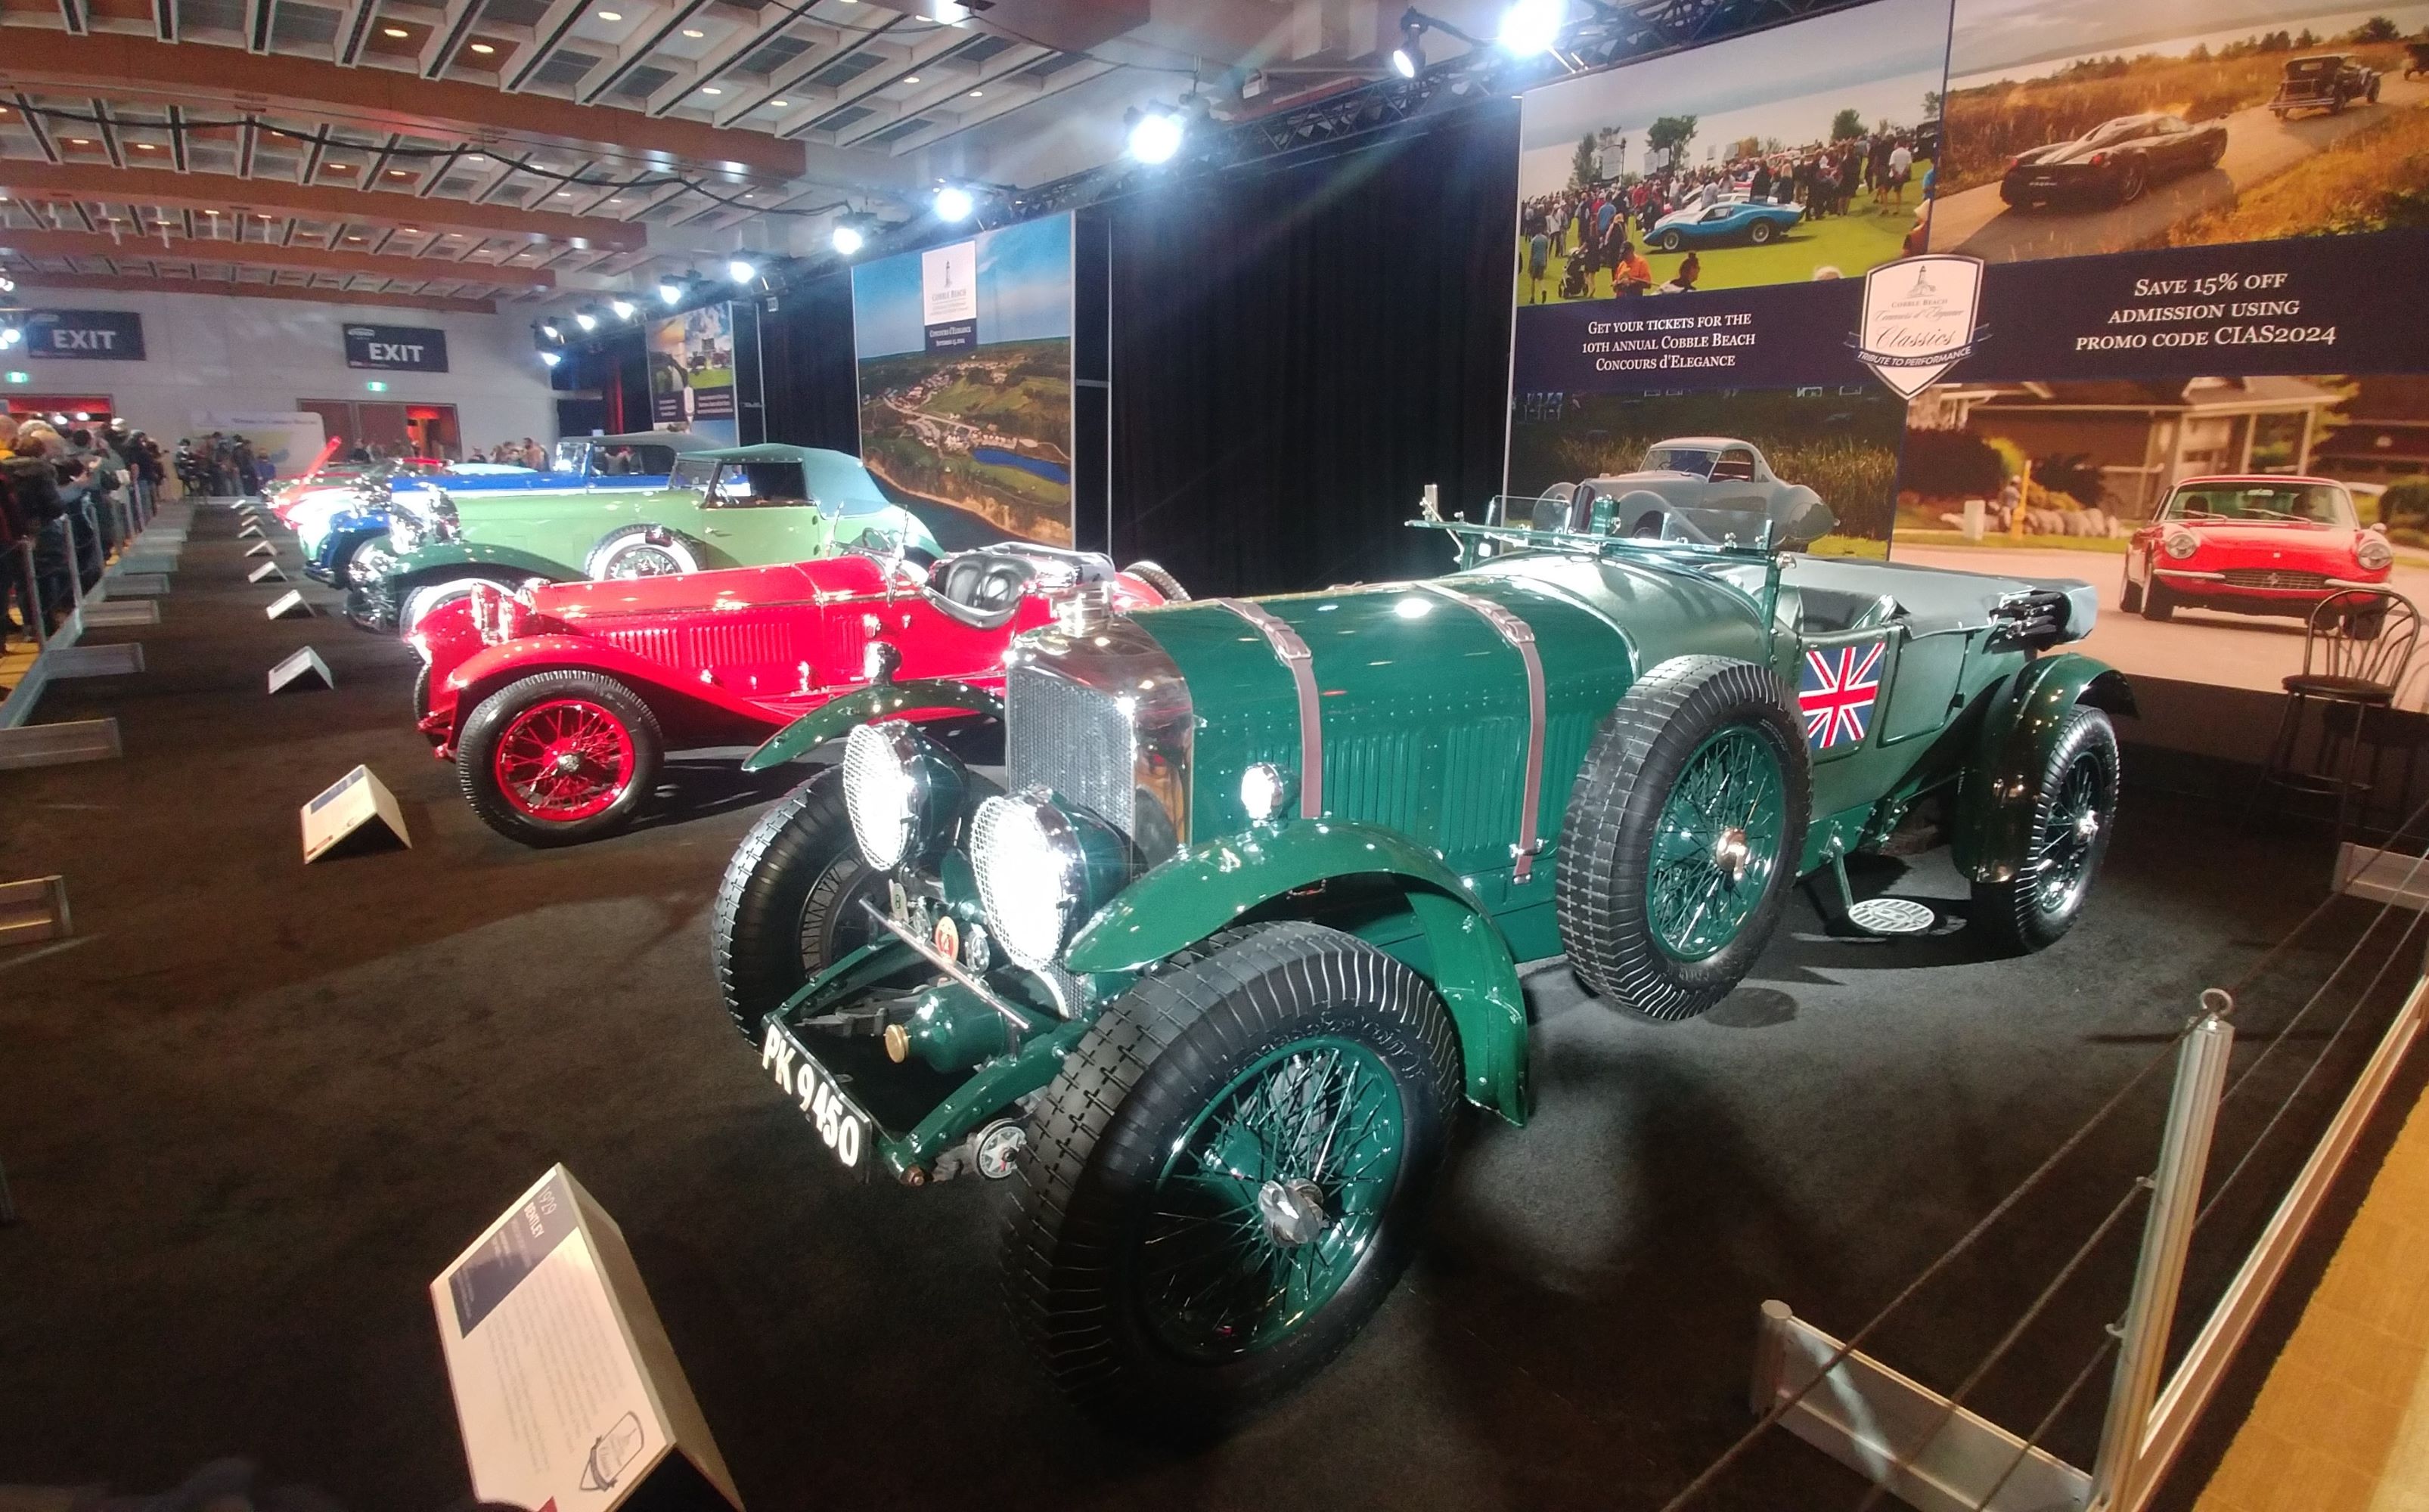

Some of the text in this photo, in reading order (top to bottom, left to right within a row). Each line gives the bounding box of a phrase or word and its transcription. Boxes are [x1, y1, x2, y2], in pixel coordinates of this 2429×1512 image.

[2135, 273, 2288, 296] SAVE 15% OFF
[1588, 313, 1752, 334] GET YOUR TICKETS FOR THE
[2108, 300, 2300, 324] ADMISSION USING
[52, 330, 116, 349] EXIT
[1582, 333, 1756, 354] 10TH ANNUAL COBBLE BEACH
[1876, 326, 1956, 349] Classics
[2075, 326, 2337, 351] PROMO CODE CIAS2024
[368, 342, 424, 362] EXIT
[1596, 355, 1736, 370] CONCOURS d'ELEGANCE
[1857, 346, 1971, 366] TRIBUTE TO PERFORMANCE
[762, 1024, 860, 1167] PK 9450
[538, 1185, 557, 1215] 1929
[523, 1201, 544, 1239] BENTLEY
